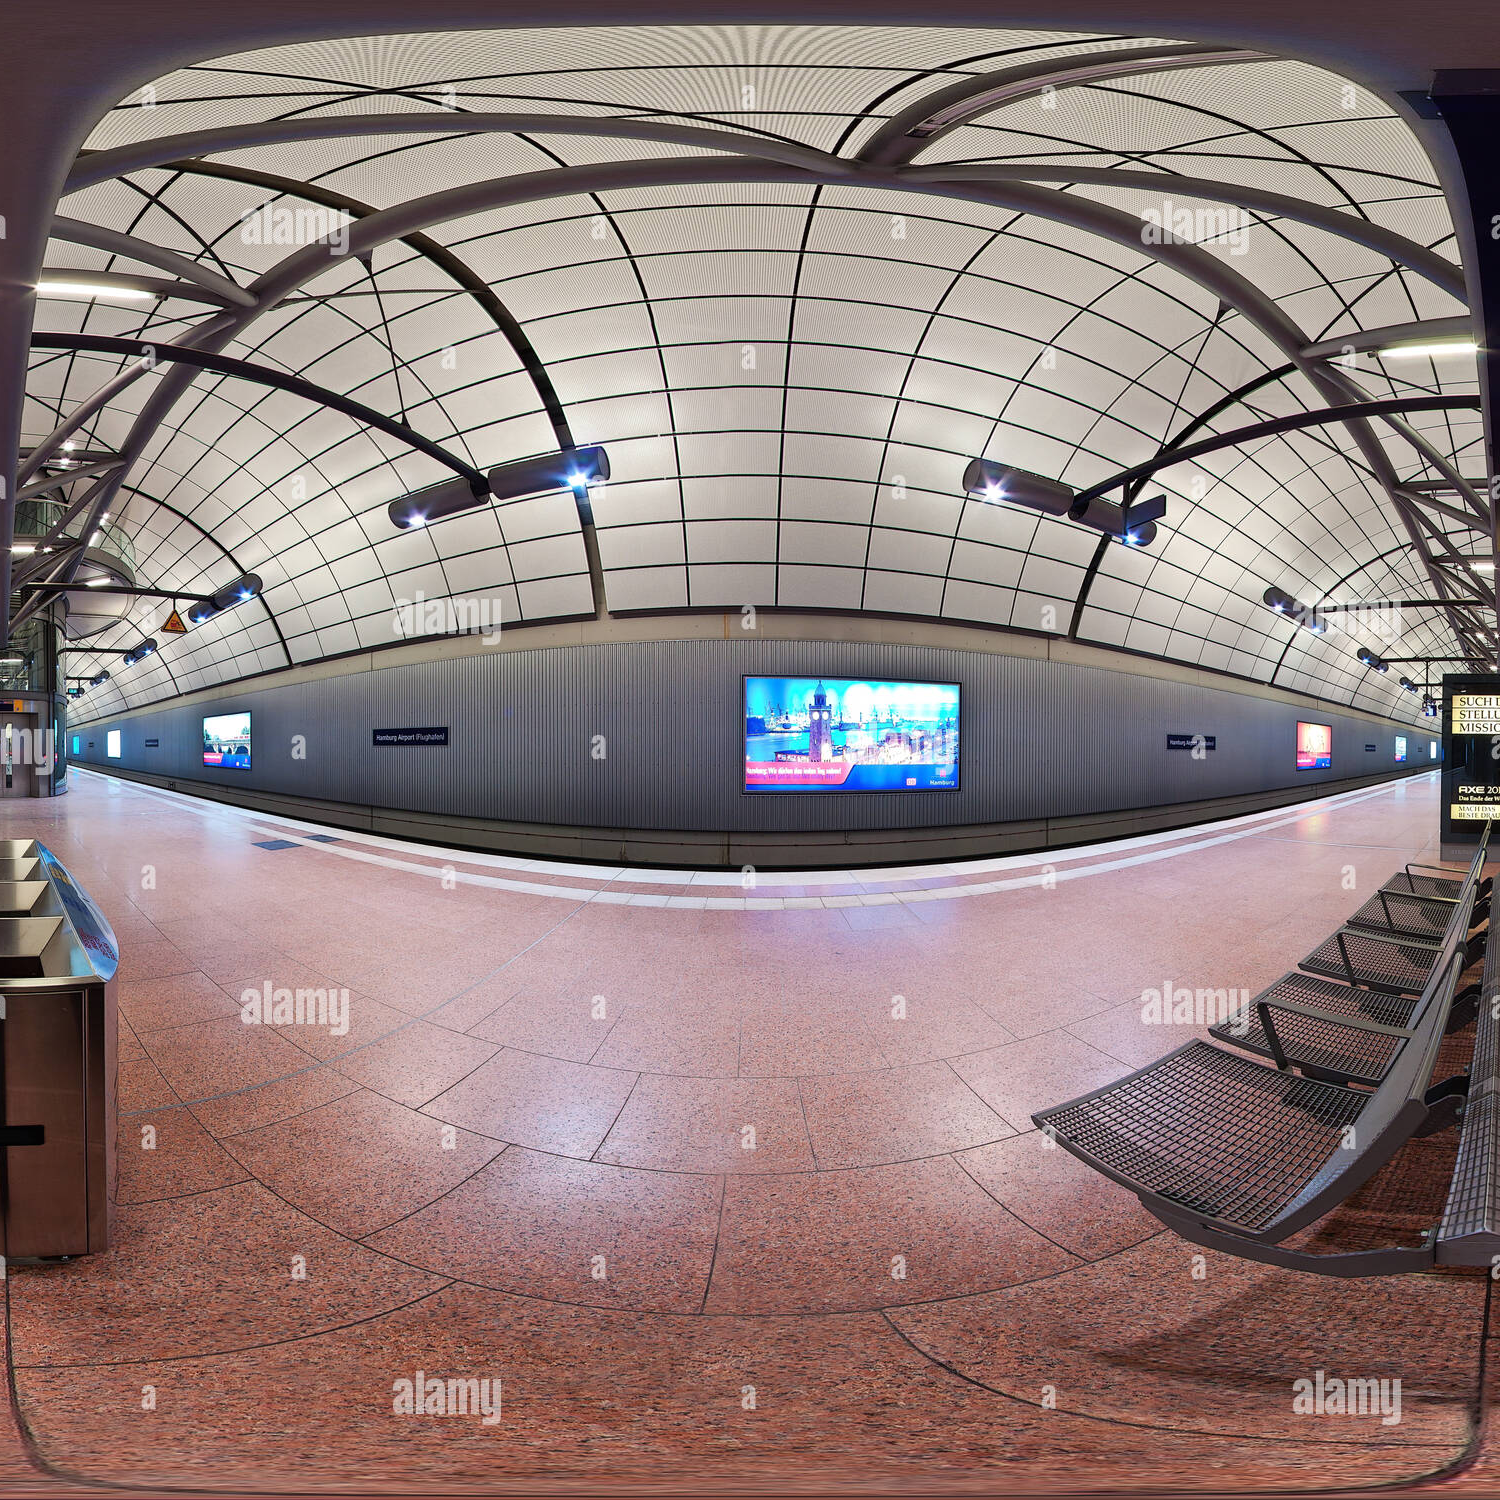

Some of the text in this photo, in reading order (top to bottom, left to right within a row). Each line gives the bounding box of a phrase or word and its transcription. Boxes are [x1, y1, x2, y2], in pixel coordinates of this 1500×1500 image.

[1460, 697, 1492, 706] SUCH
[376, 734, 397, 742] Hamburg
[416, 733, 445, 741] (Flughafen)
[1458, 786, 1485, 794] AXE
